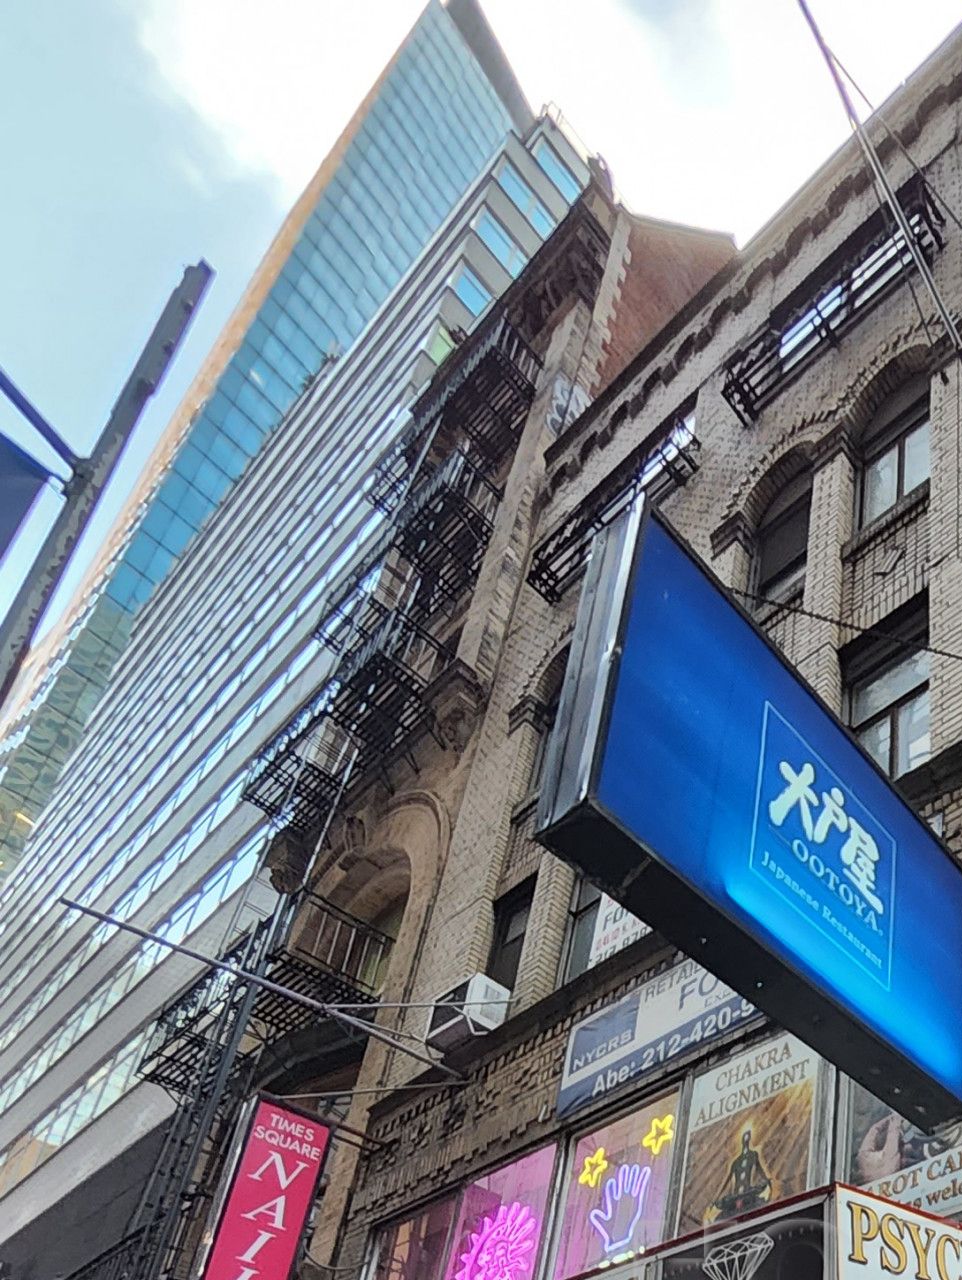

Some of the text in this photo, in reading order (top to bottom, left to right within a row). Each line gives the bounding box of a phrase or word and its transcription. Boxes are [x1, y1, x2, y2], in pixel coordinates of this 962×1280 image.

[791, 839, 879, 933] OOTOYA
[762, 851, 883, 970] Japanese Restaurant
[572, 1029, 633, 1071] NYCRS
[715, 1041, 792, 1092] CHAKRA
[592, 1060, 638, 1097] Abe:
[694, 1058, 810, 1127] ALIGNMENT
[253, 1125, 321, 1161] SQUARE
[270, 1112, 315, 1142] TIMES
